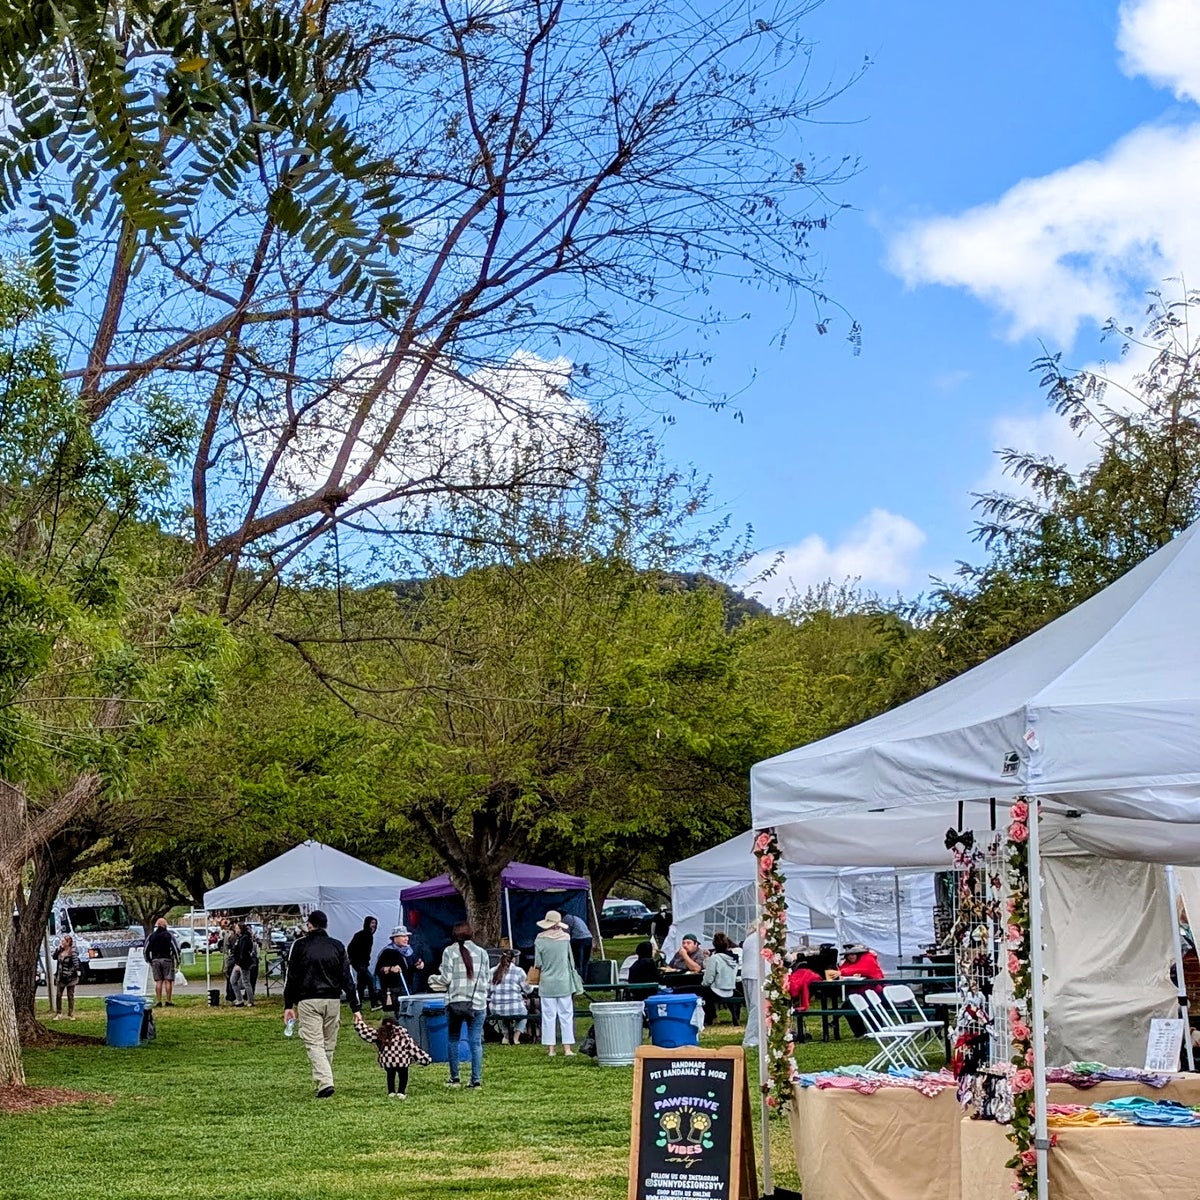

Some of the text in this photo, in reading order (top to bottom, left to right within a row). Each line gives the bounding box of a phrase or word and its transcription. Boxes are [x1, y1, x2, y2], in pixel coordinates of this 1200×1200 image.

[671, 1060, 707, 1069] HANDMADE
[649, 1070, 662, 1080] PET
[662, 1068, 700, 1078] BANDANAS
[707, 1069, 728, 1080] MORE
[653, 1096, 720, 1111] PAWSITIVE
[667, 1143, 703, 1155] VIBES
[664, 1155, 703, 1169] only
[650, 1172, 670, 1180] FOLLOW
